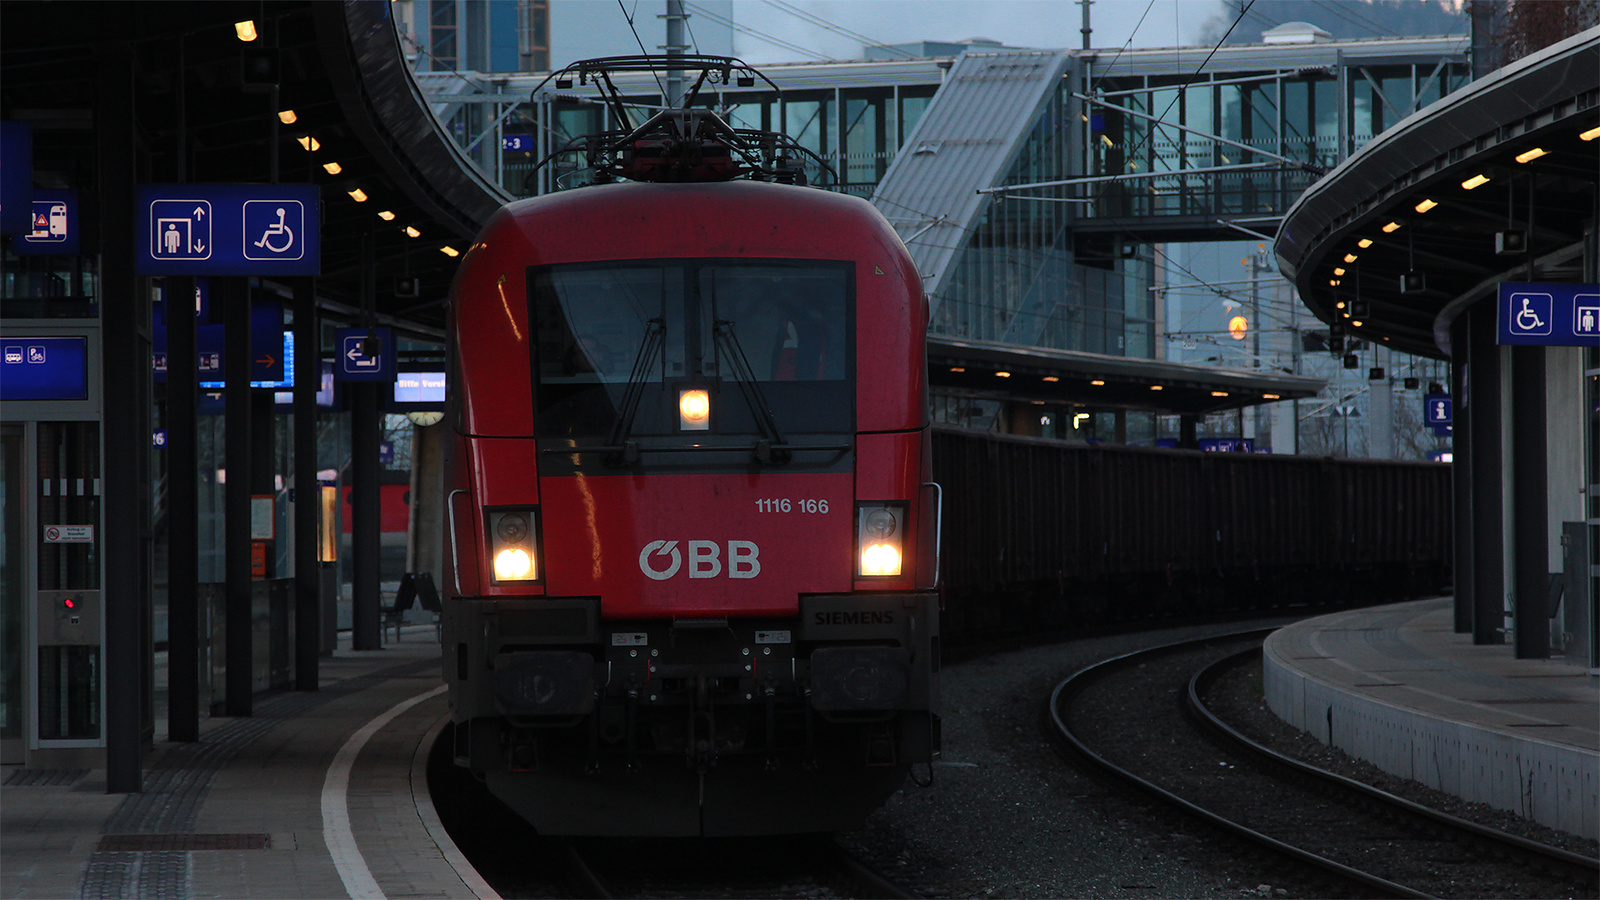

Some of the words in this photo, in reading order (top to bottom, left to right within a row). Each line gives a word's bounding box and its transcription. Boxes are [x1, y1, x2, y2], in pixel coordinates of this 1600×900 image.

[755, 498, 792, 513] 1116
[798, 498, 829, 514] 166
[638, 539, 761, 581] ÖBB
[815, 610, 894, 625] SIEMENS
